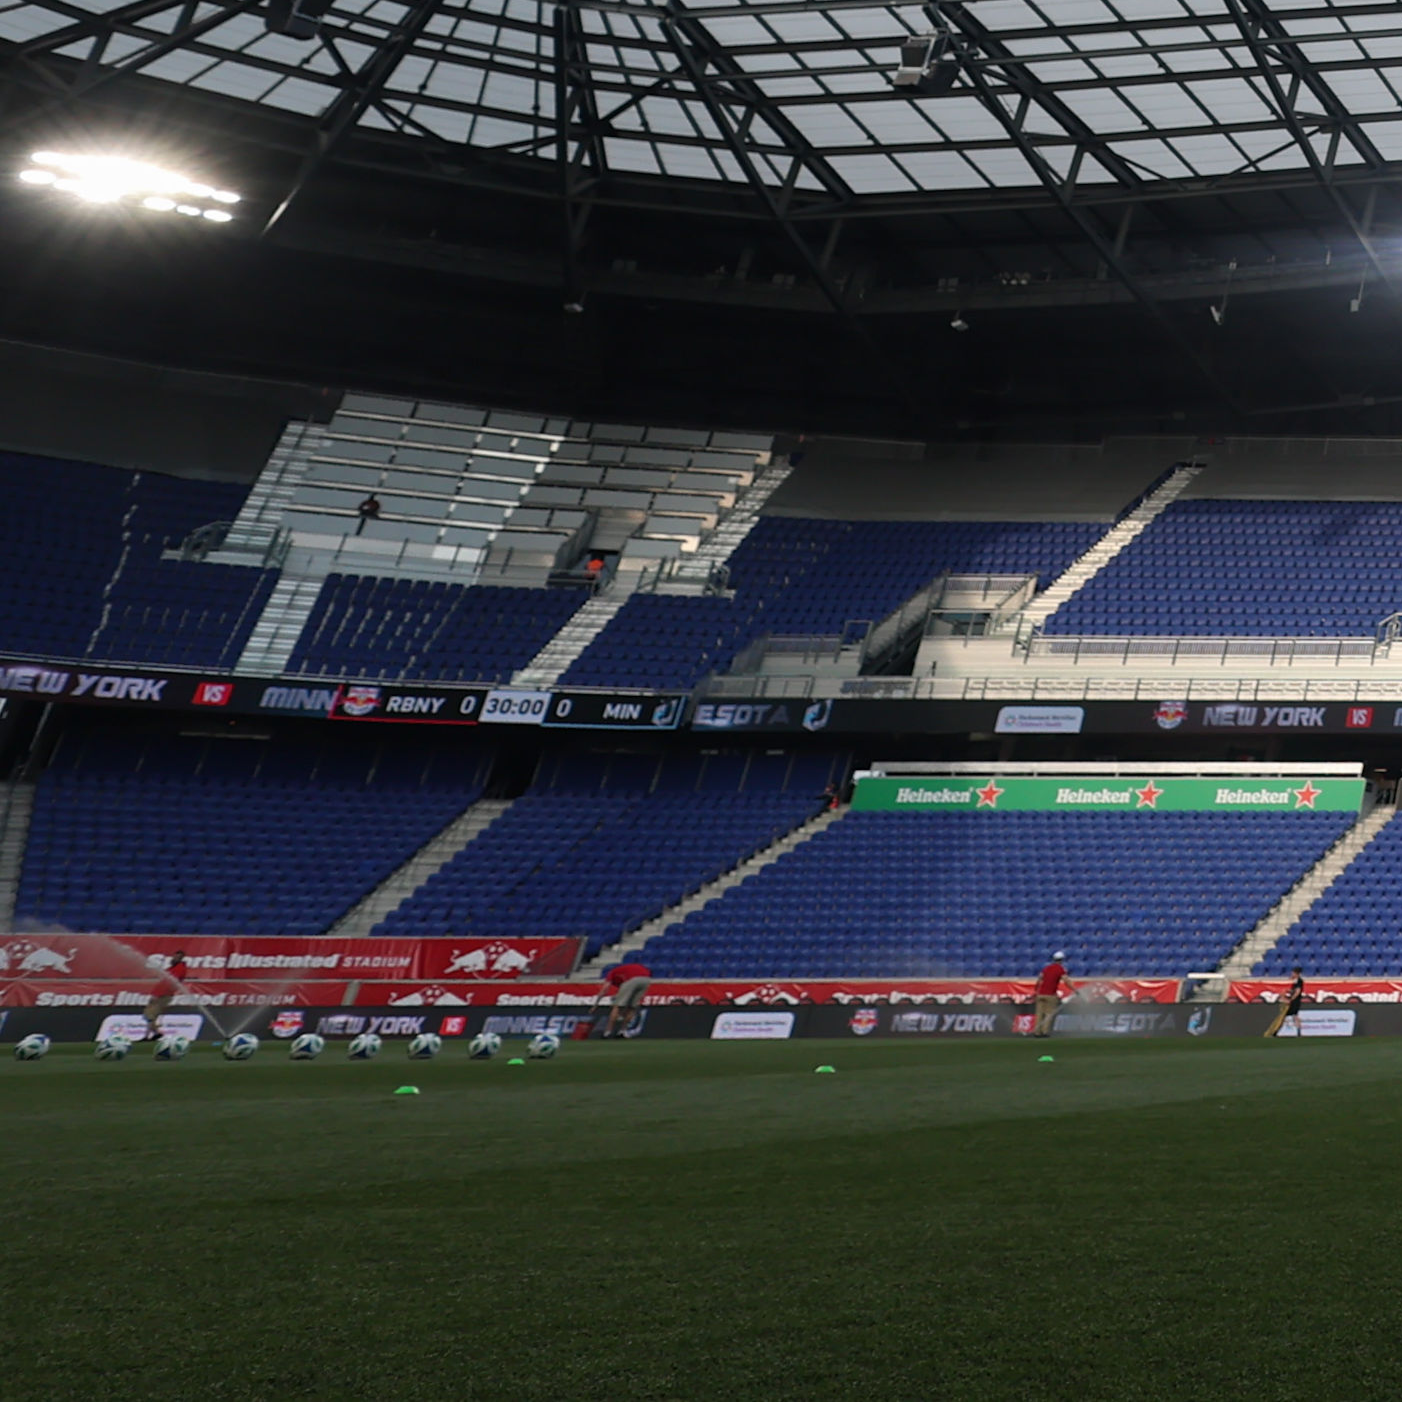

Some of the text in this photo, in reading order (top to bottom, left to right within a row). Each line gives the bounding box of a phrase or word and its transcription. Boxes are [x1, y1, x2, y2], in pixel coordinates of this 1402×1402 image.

[70, 674, 168, 702] YORK
[202, 683, 226, 703] VS
[386, 696, 477, 715] RBNY 0
[486, 698, 545, 717] 30:00
[555, 700, 643, 720] 0 MIN
[1202, 706, 1258, 727] NEW
[1261, 707, 1326, 727] YORK
[1351, 708, 1369, 726] VS
[896, 788, 972, 803] Heineken
[1056, 788, 1131, 804] Heineken
[1215, 788, 1291, 804] Heineken
[145, 953, 412, 971] Sprts Illustrated STADIUM
[36, 991, 297, 1007] Sports Illuated STADIUM
[366, 1016, 426, 1035] YORK
[482, 1015, 612, 1035] MINNESOT
[890, 1013, 939, 1032] NEW
[939, 1014, 996, 1032] YORK
